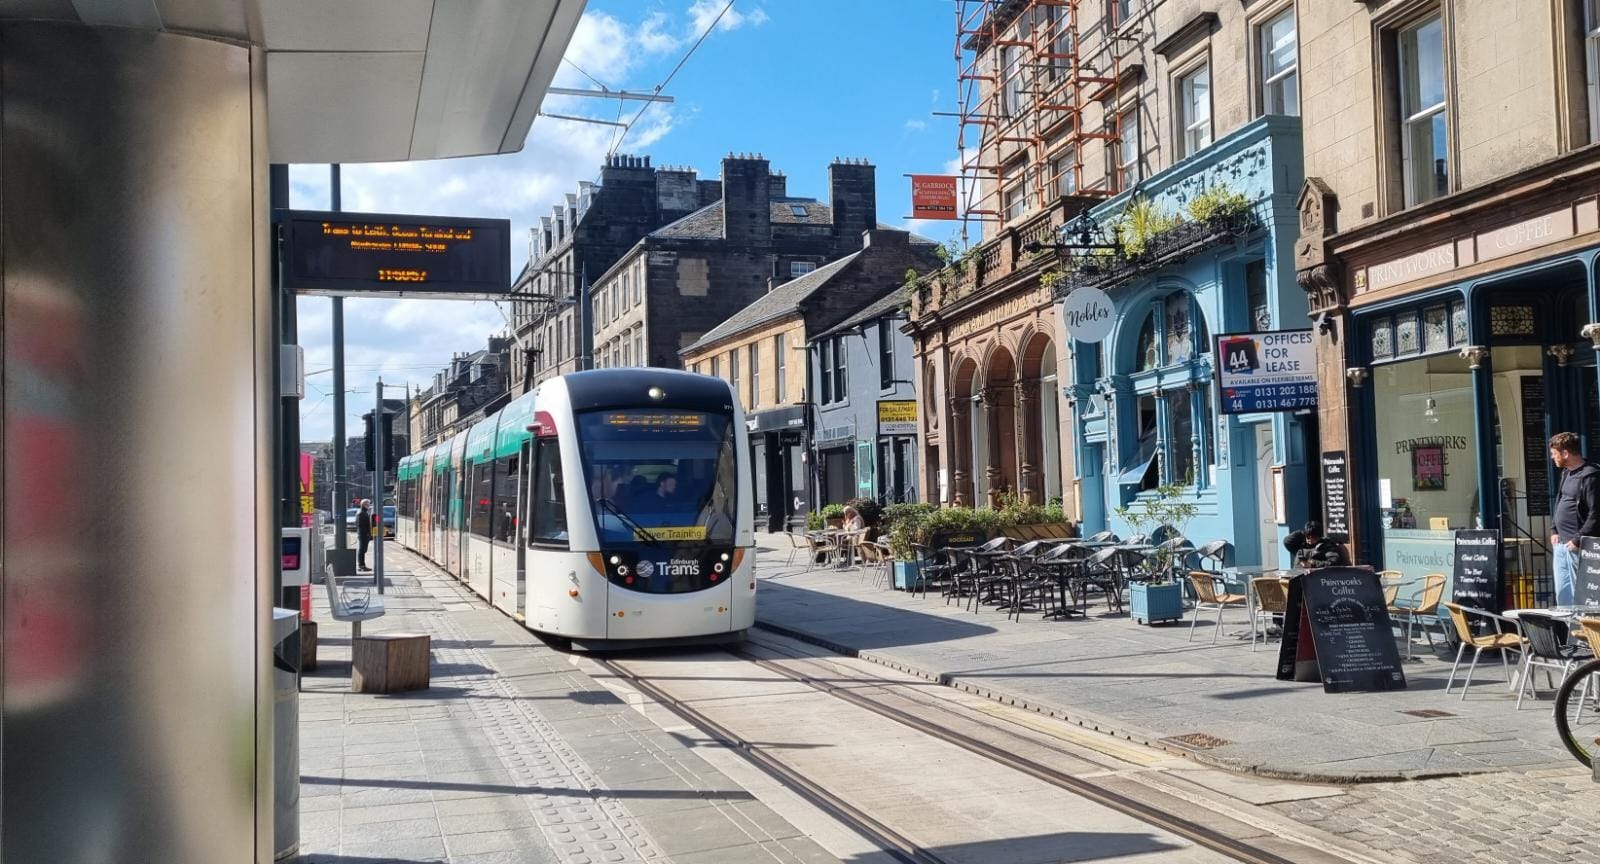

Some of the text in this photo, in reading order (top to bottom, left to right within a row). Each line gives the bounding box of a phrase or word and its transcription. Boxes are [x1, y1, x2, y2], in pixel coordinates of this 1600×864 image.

[1496, 216, 1552, 248] COFFEE
[1371, 247, 1454, 284] PRINTWORKS
[1067, 301, 1109, 327] Nobles
[1264, 333, 1312, 346] OFFICES
[1230, 350, 1248, 368] 44
[1265, 348, 1289, 359] FOR
[1266, 361, 1300, 372] LEASE
[1254, 388, 1276, 397] 0131
[1280, 387, 1296, 396] 202
[1256, 400, 1277, 409] 0131
[1280, 398, 1297, 407] 467
[1395, 436, 1467, 454] PRINTWORKS
[667, 528, 702, 538] Training
[670, 558, 698, 566] Edinburgh
[656, 561, 699, 576] Trams
[1320, 577, 1362, 586] Printworks
